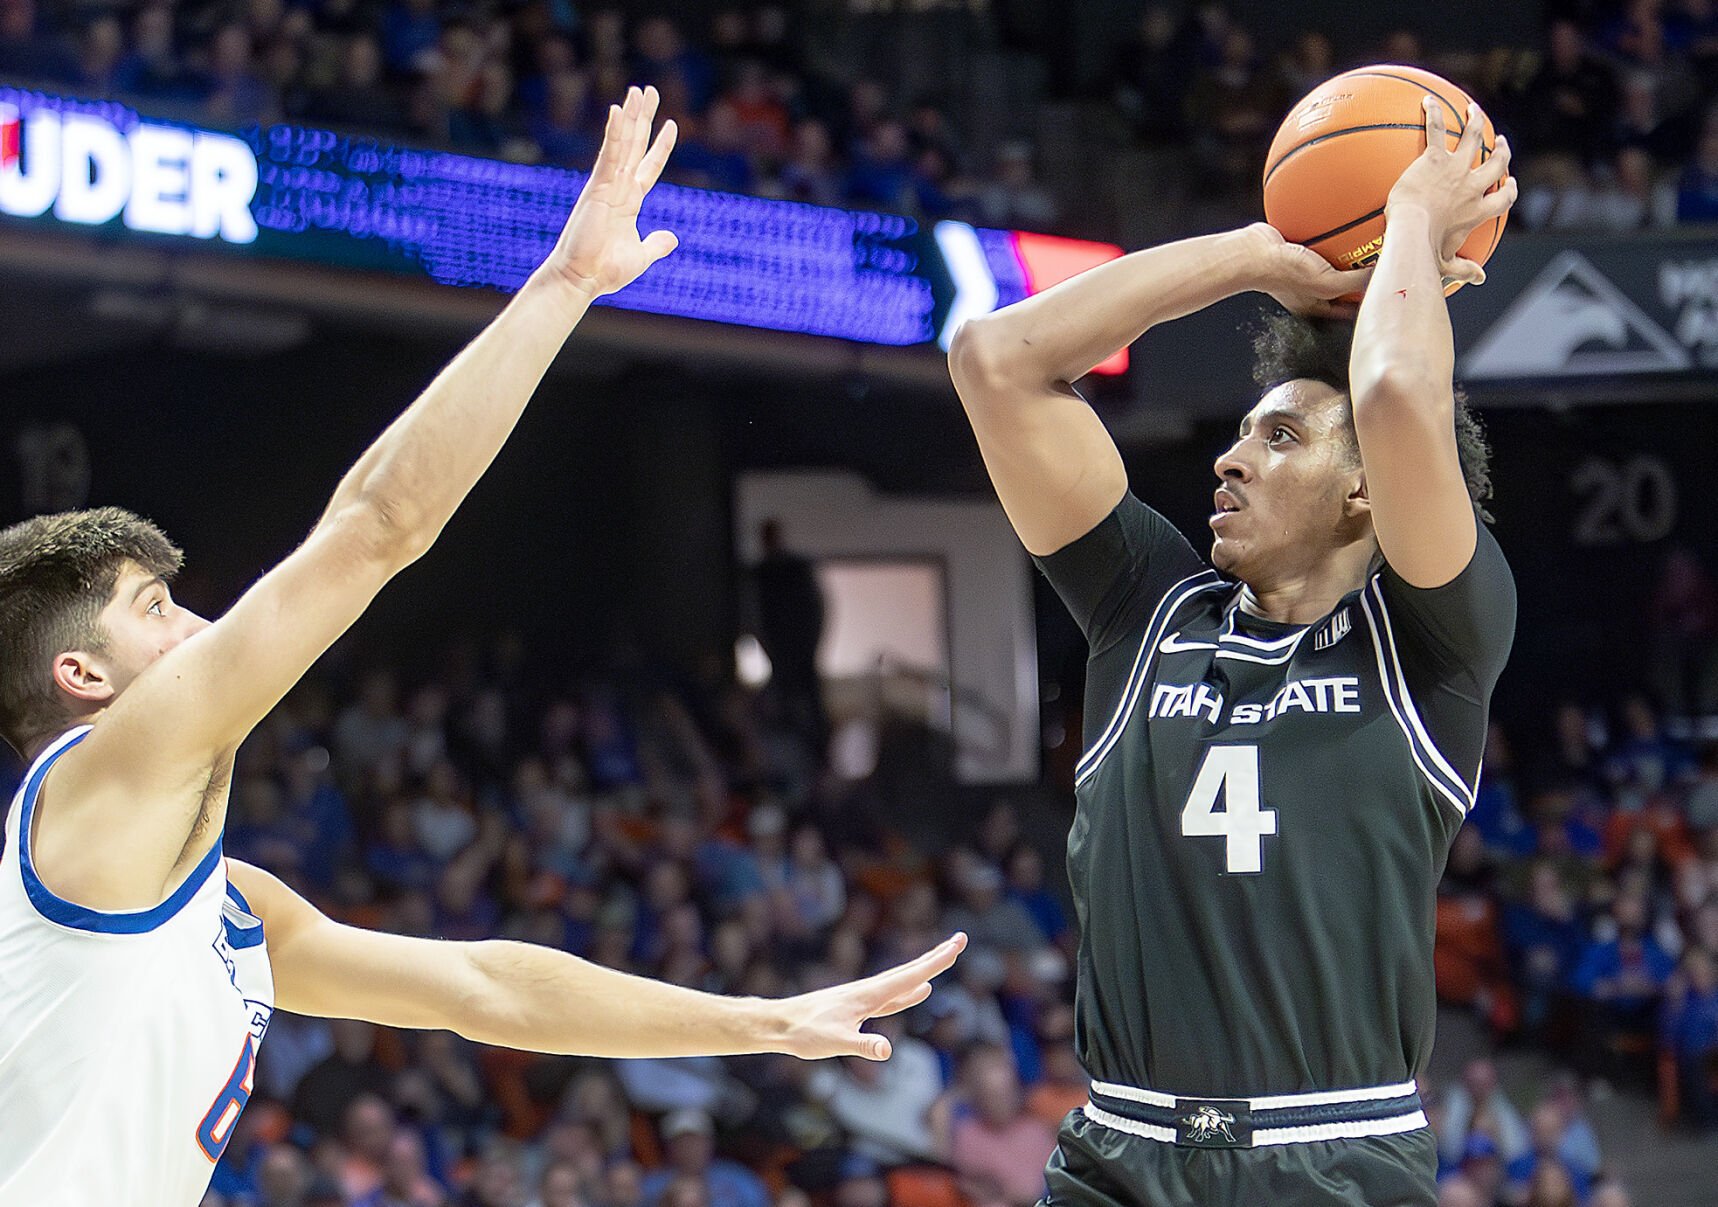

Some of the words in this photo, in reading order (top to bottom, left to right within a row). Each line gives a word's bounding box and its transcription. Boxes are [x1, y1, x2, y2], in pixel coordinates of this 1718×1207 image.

[0, 104, 259, 244] UDER
[1571, 454, 1677, 543] 20
[1229, 676, 1361, 725] STATE
[1181, 744, 1278, 875] 4
